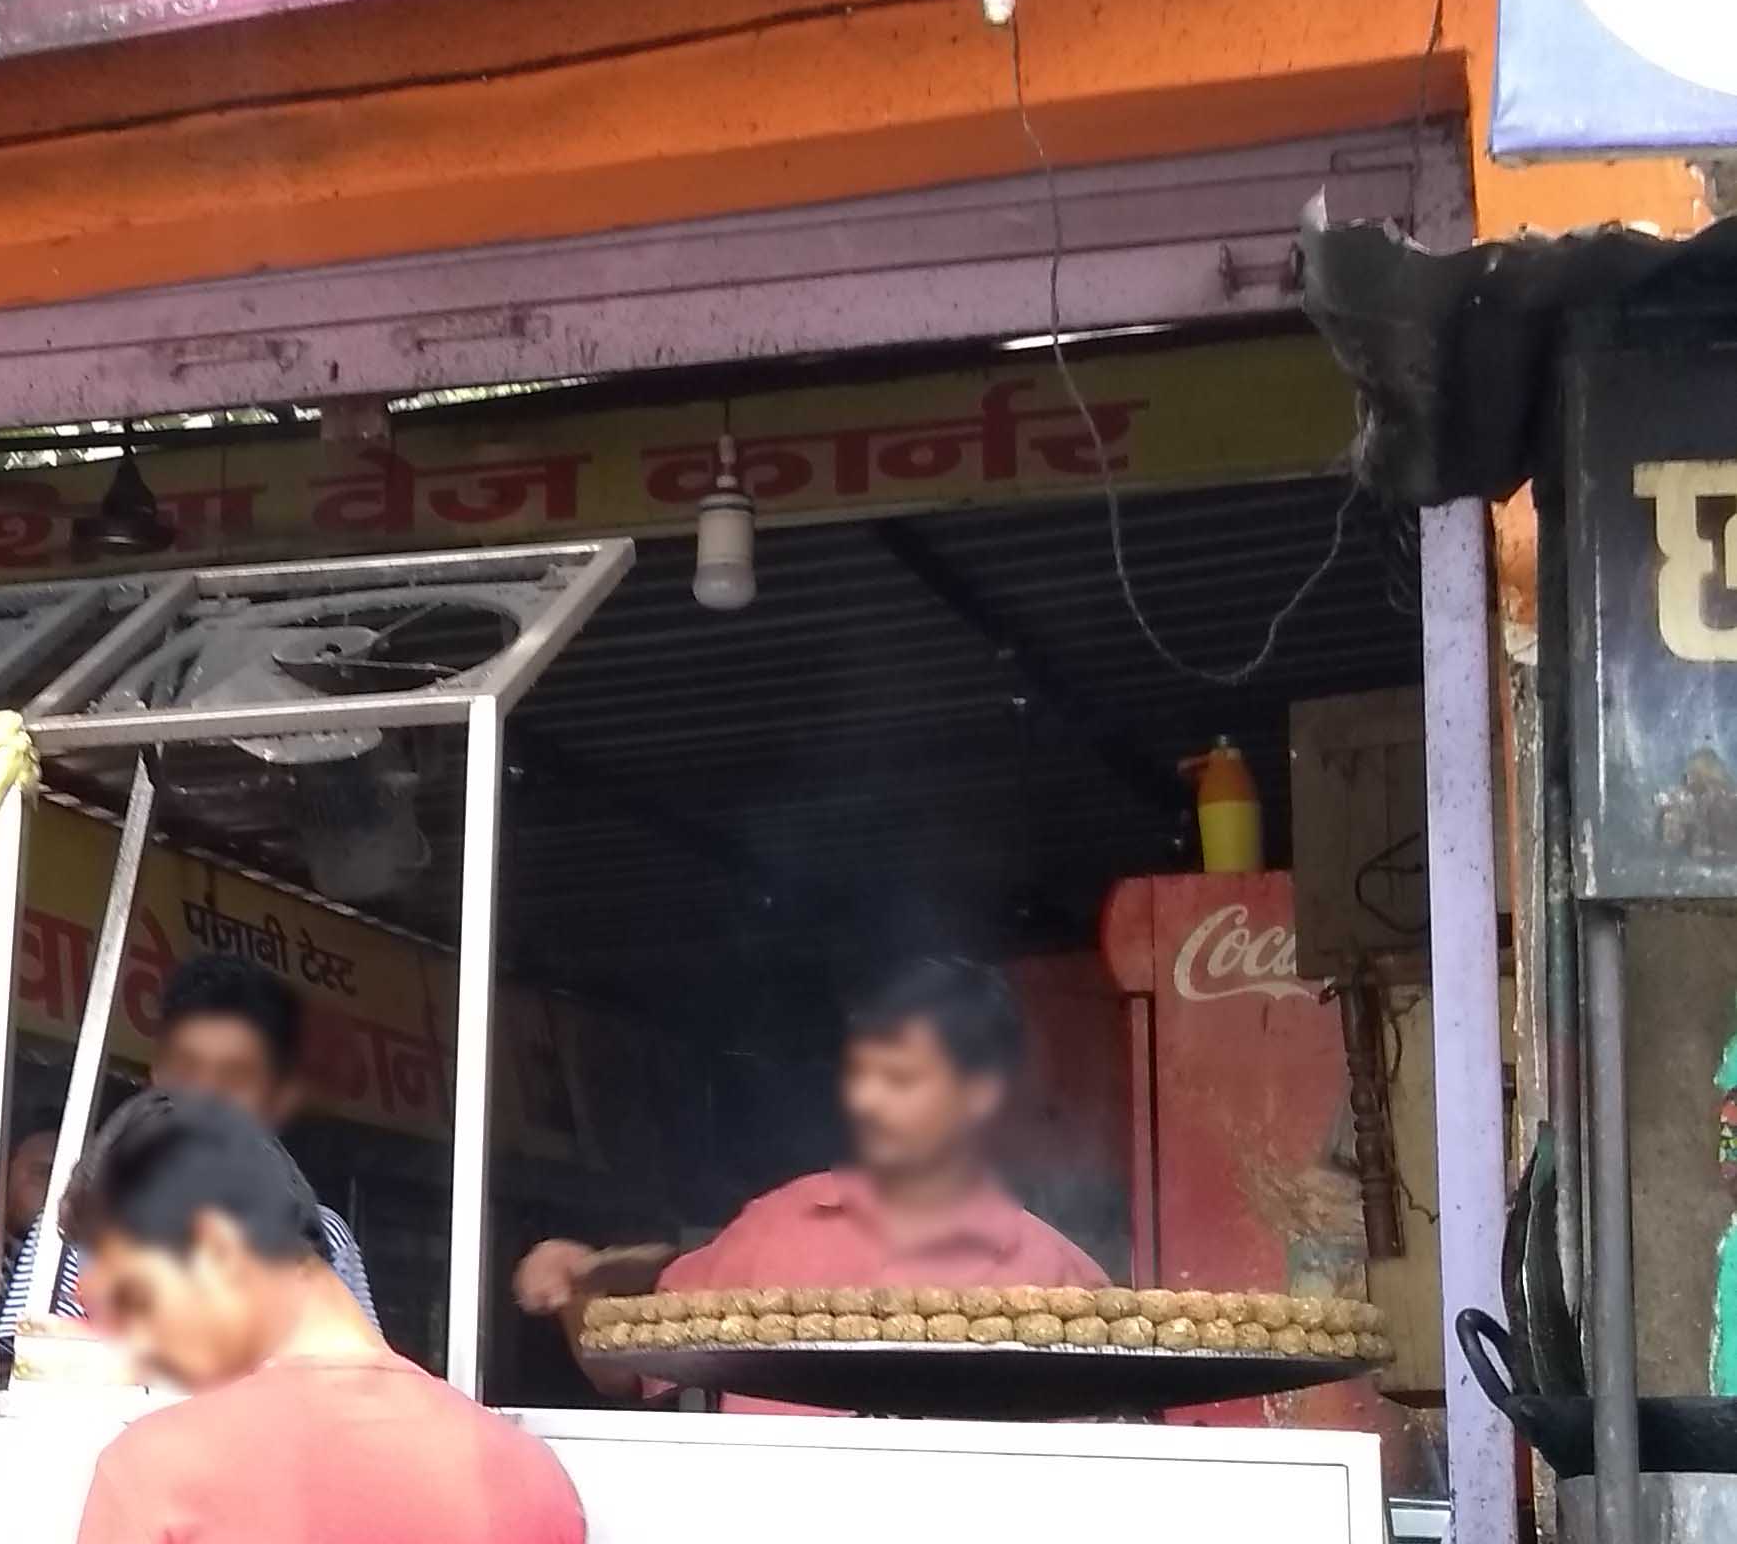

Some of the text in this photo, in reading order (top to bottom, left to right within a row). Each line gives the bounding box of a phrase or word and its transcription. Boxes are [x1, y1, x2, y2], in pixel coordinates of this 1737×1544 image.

[308, 450, 594, 532] वेज
[645, 384, 1147, 503] कार्नर
[181, 894, 294, 973] पंजाबी
[298, 928, 358, 996] टेस्ट
